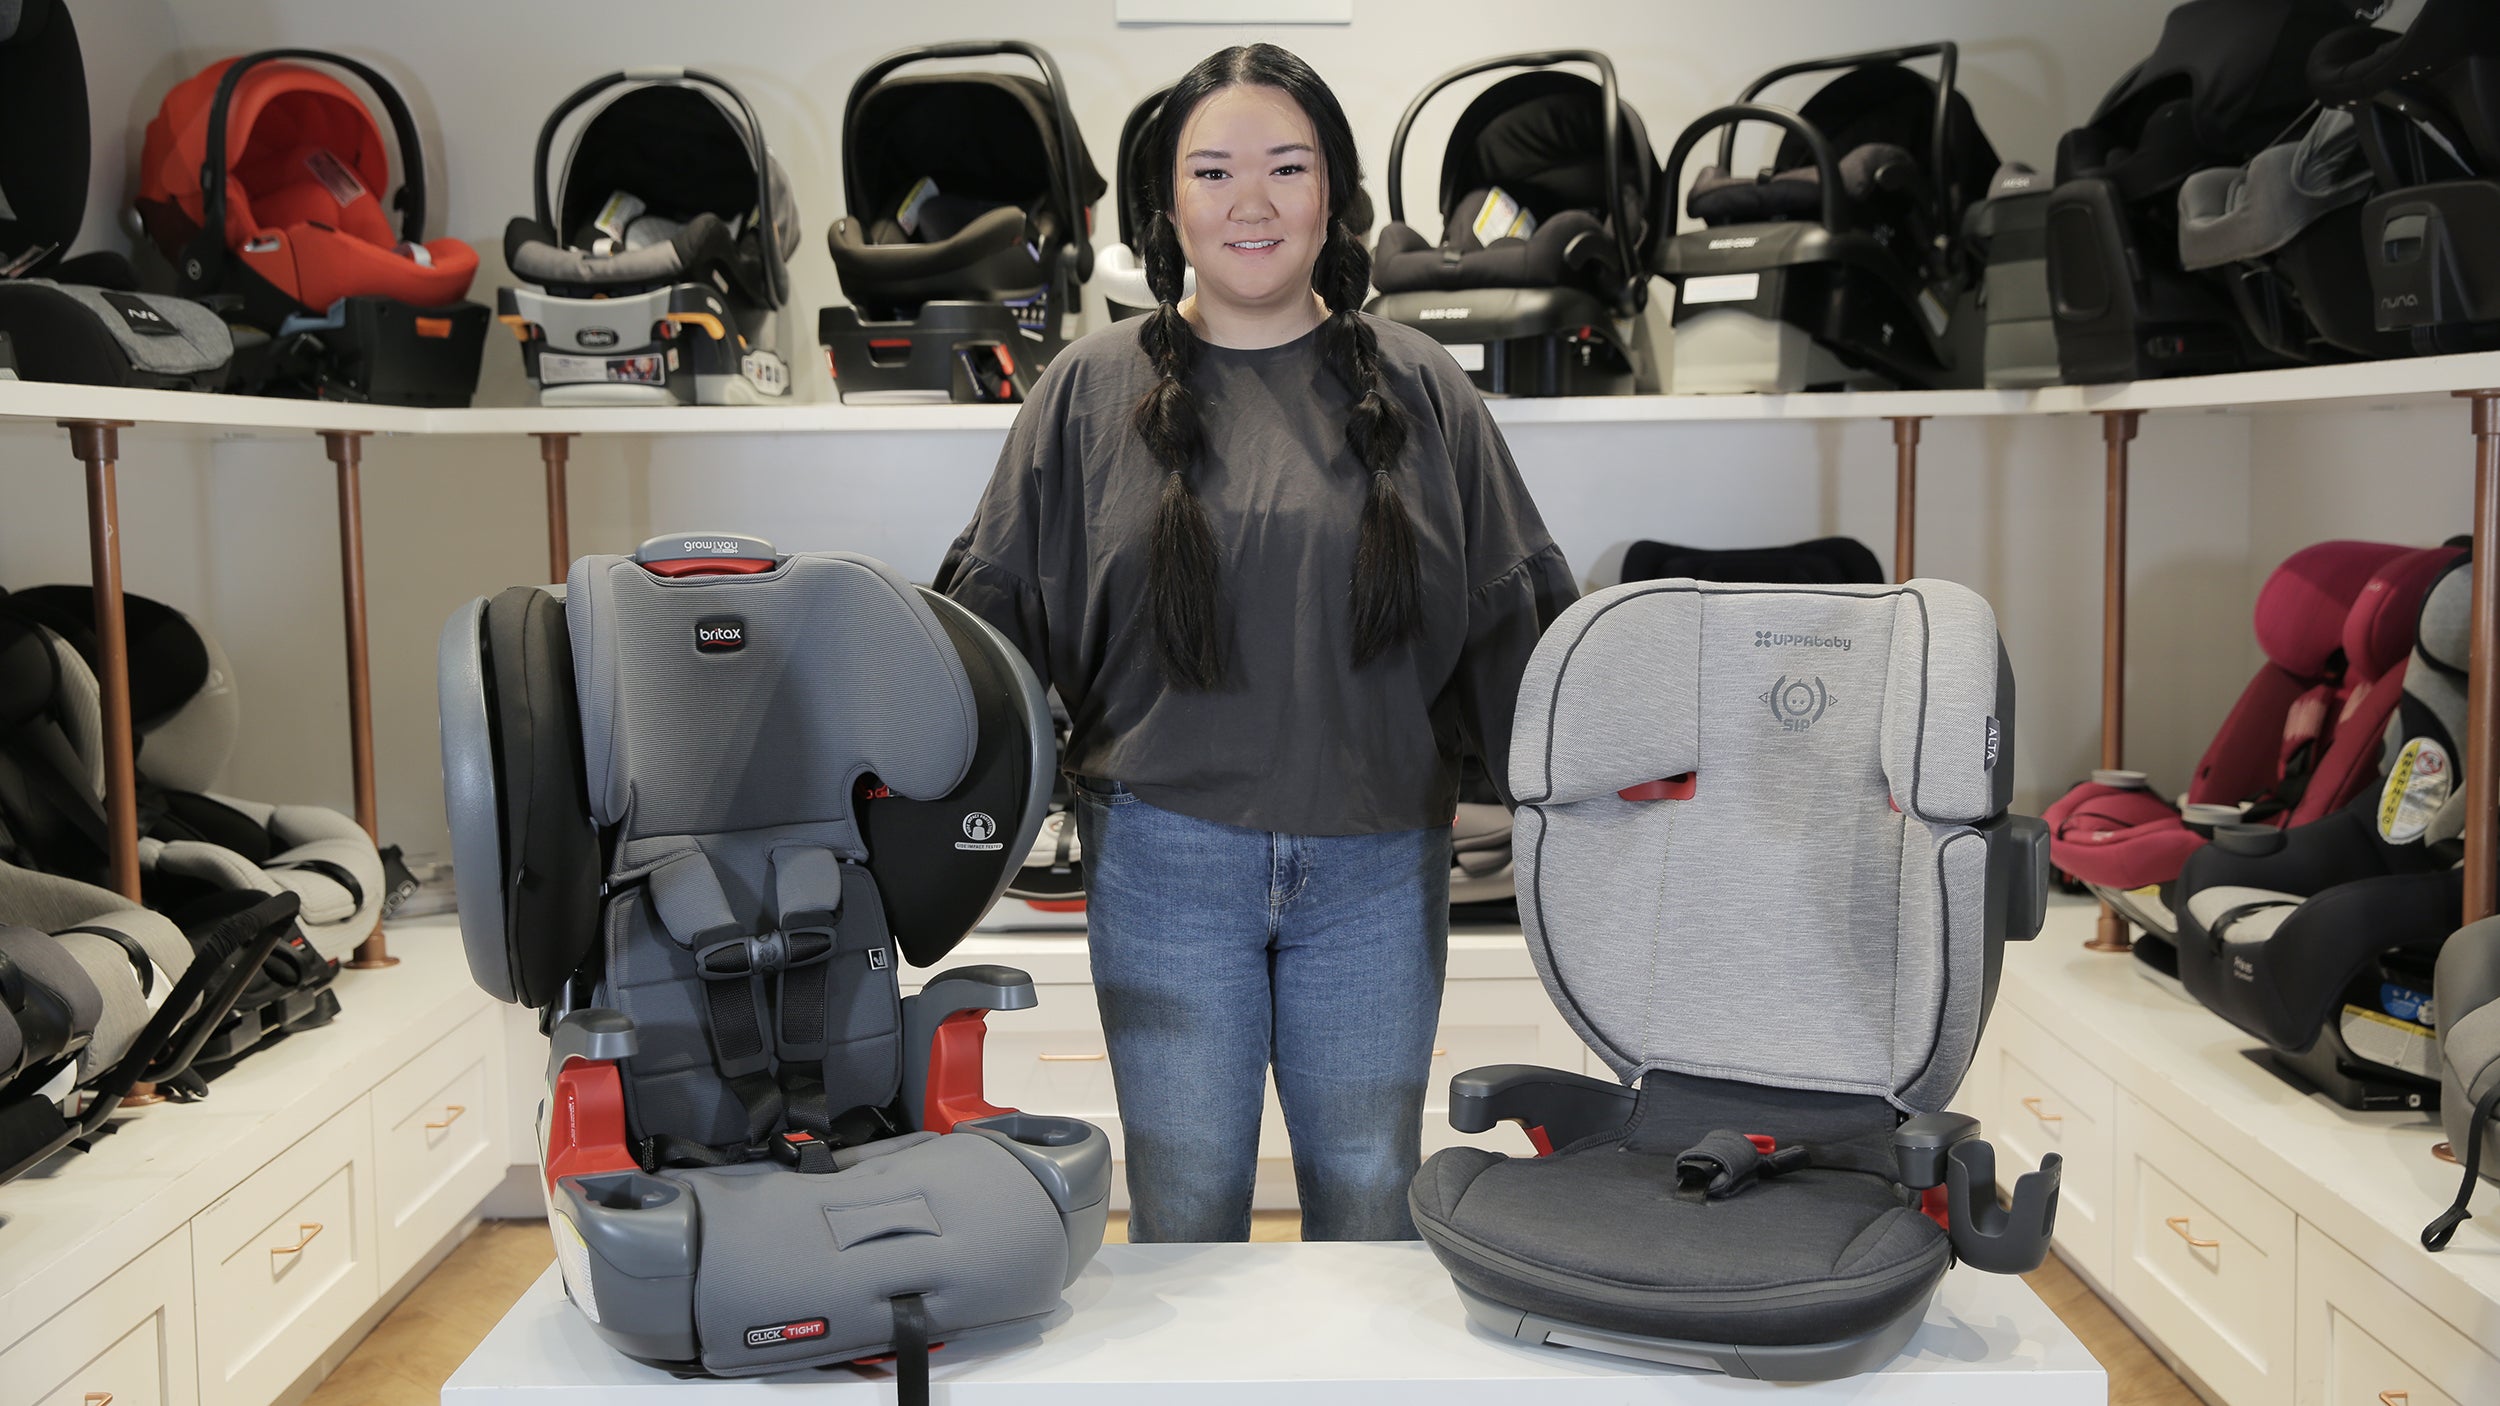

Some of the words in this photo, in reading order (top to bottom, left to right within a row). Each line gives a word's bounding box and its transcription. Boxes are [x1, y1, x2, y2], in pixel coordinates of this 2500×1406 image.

[2381, 294, 2418, 309] nuna
[684, 541, 712, 552] grow
[717, 541, 738, 550] you
[700, 628, 741, 640] britax
[1773, 634, 1851, 651] UPPAbaby
[1783, 718, 1810, 732] SIP
[1987, 726, 1997, 760] ALTA
[751, 1330, 781, 1342] CLICK
[788, 1324, 820, 1336] TIGHT
